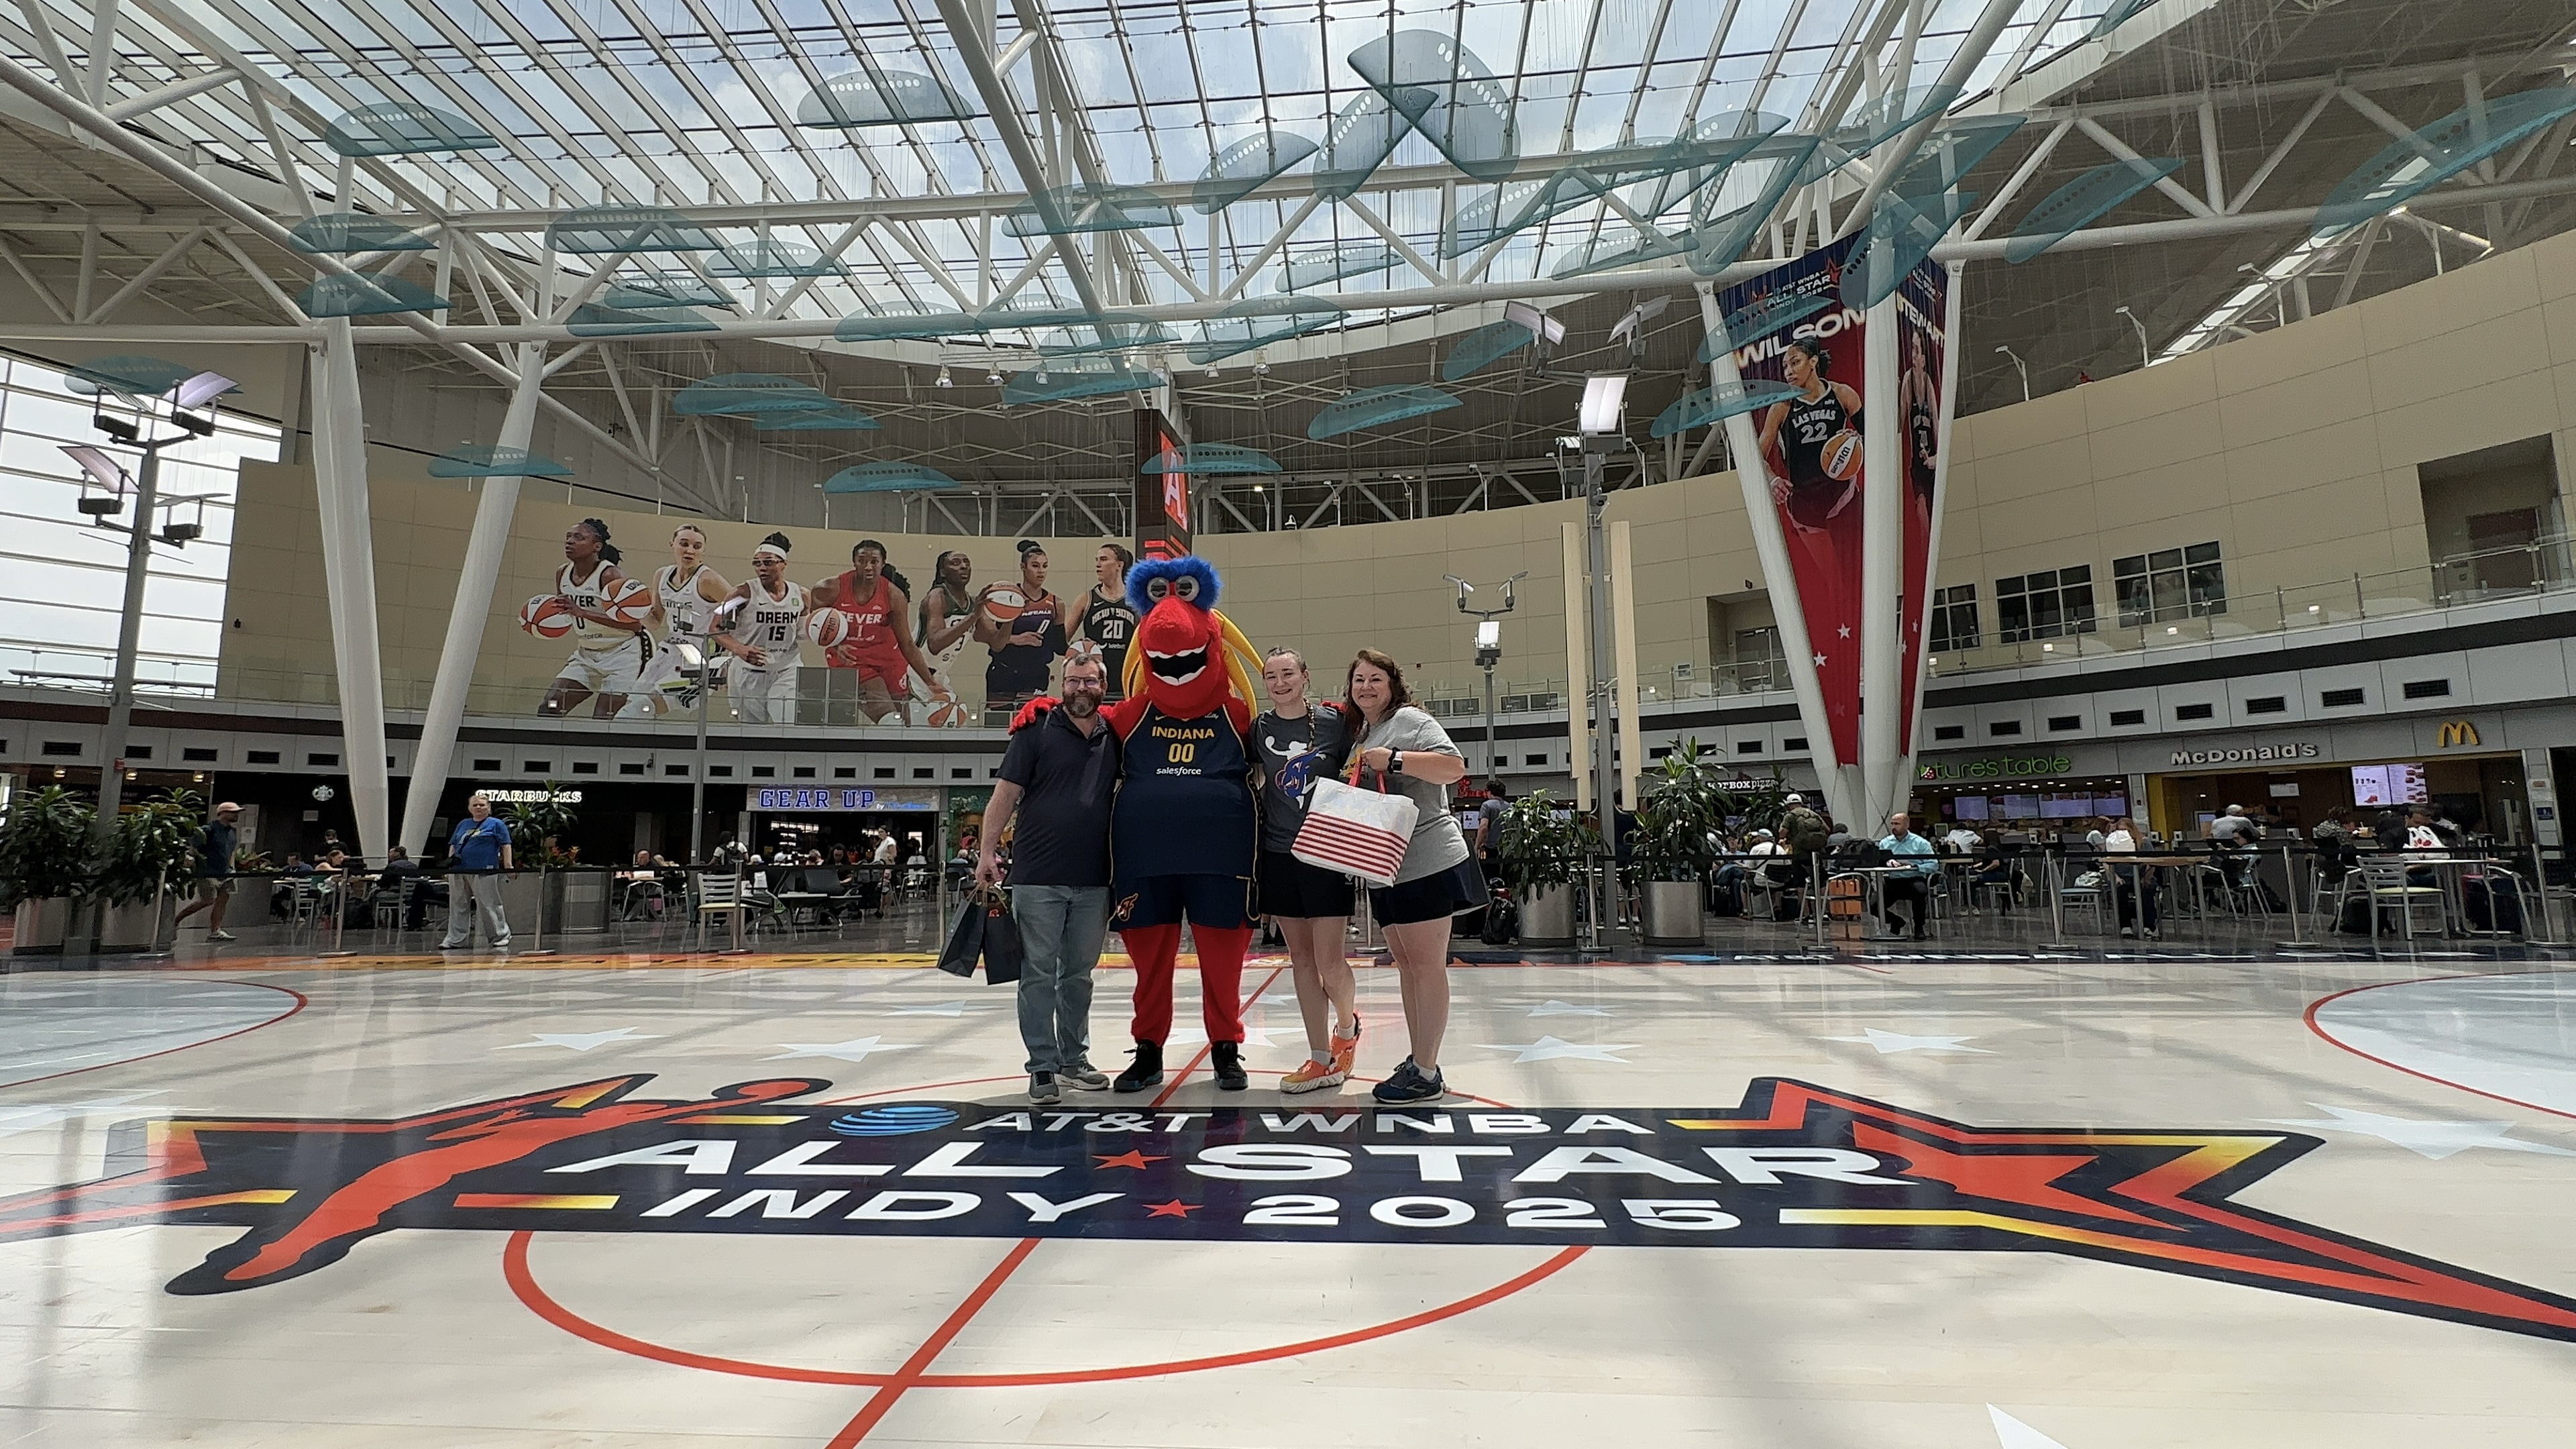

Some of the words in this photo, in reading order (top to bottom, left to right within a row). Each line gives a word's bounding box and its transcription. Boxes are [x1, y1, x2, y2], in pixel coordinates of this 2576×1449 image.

[1797, 272, 1820, 284] WNBA
[1766, 292, 1792, 307] ALL
[1796, 274, 1831, 294] STAR
[1734, 307, 1866, 370] WILSON
[1791, 413, 1809, 429] LAS
[1809, 409, 1836, 421] VEGAS
[1801, 422, 1827, 444] 22
[756, 611, 799, 623] DREAM
[1091, 607, 1110, 625] NEW
[768, 626, 786, 641] 15
[1037, 619, 1051, 635] 0
[1102, 619, 1124, 639] 20
[1151, 726, 1215, 739] INDIANA
[1168, 743, 1195, 763] 00
[2170, 743, 2317, 765] McDonald's
[1156, 766, 1202, 776] salesforce
[2000, 755, 2071, 775] table
[759, 789, 830, 809] GEAR
[841, 790, 875, 809] UP
[962, 1112, 1213, 1132] AT&T
[1258, 1112, 1656, 1134] WNBA
[543, 1138, 1065, 1177] ALL
[1185, 1142, 1920, 1185] STAR
[639, 1188, 1127, 1222] INDY
[1242, 1193, 1741, 1230] 2025
